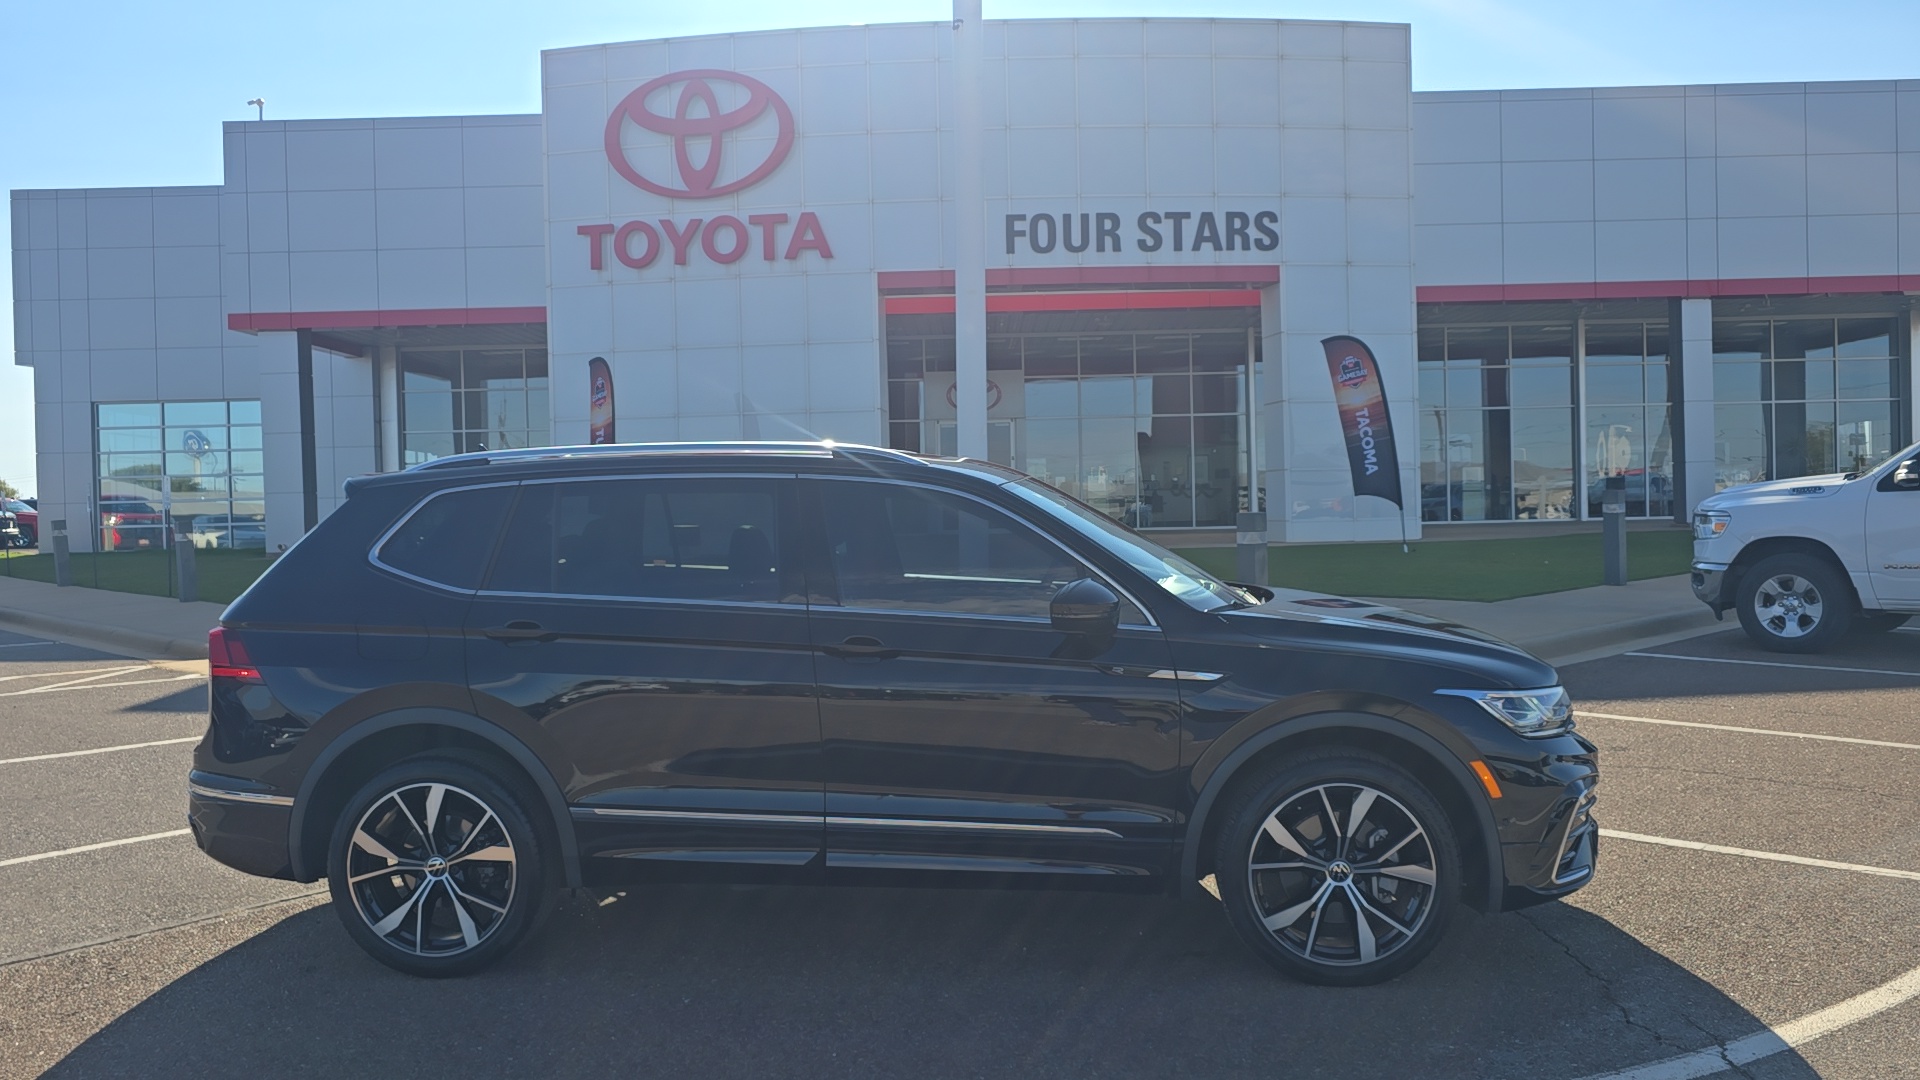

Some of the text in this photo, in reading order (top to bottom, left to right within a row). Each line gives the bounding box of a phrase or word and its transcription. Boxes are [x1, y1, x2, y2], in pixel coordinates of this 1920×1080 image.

[577, 211, 833, 270] TOYOTA
[1005, 211, 1280, 254] FOUR STARS
[1355, 408, 1378, 475] TACOMA
